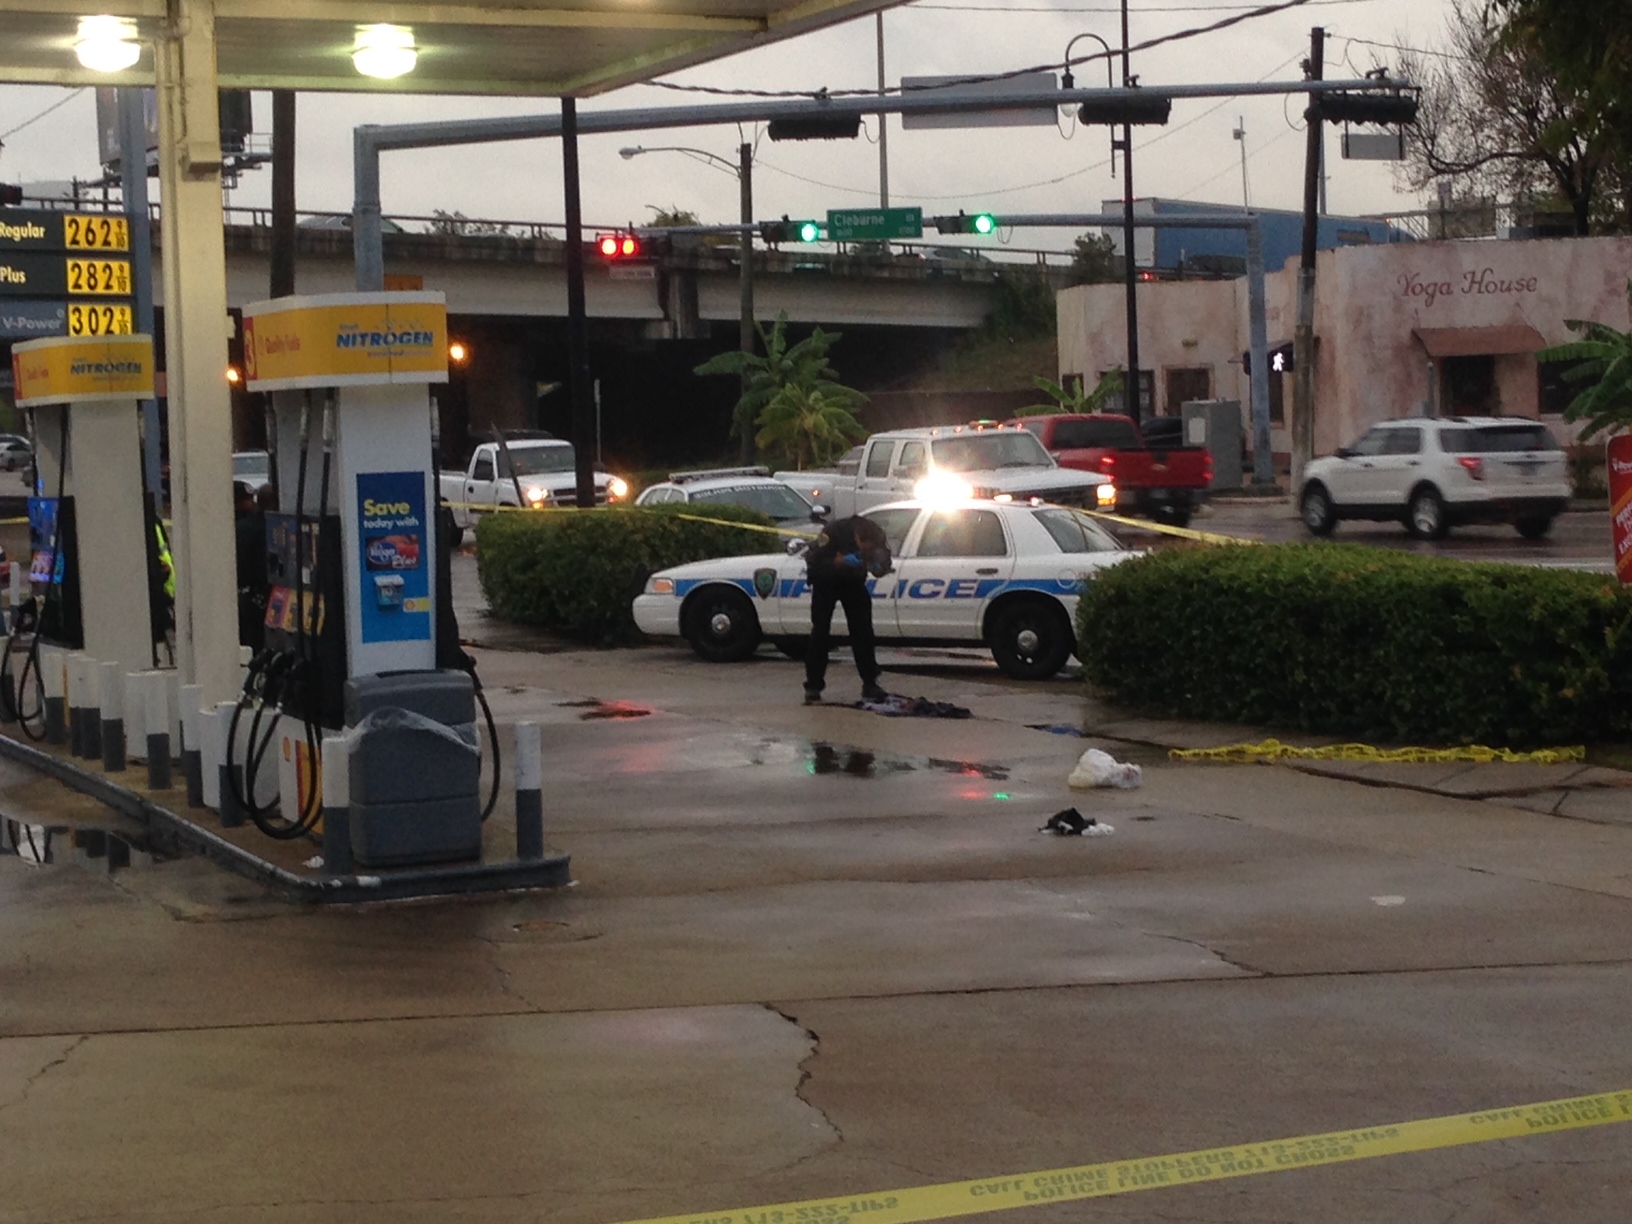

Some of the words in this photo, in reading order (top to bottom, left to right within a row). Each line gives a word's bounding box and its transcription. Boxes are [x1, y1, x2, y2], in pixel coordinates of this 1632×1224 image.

[833, 214, 885, 227] Cleburne
[0, 221, 46, 241] Regular
[68, 218, 112, 247] 262
[0, 266, 26, 284] Plus
[70, 263, 114, 290] 282
[1397, 271, 1454, 307] Yoga
[1461, 267, 1538, 295] House
[3, 316, 62, 330] V-Power
[72, 306, 115, 335] 302
[336, 330, 434, 348] NITROGEN
[70, 357, 142, 375] NITROGEN
[364, 499, 410, 516] Save
[363, 517, 394, 530] today
[395, 516, 419, 527] with
[791, 578, 979, 600] PLICE
